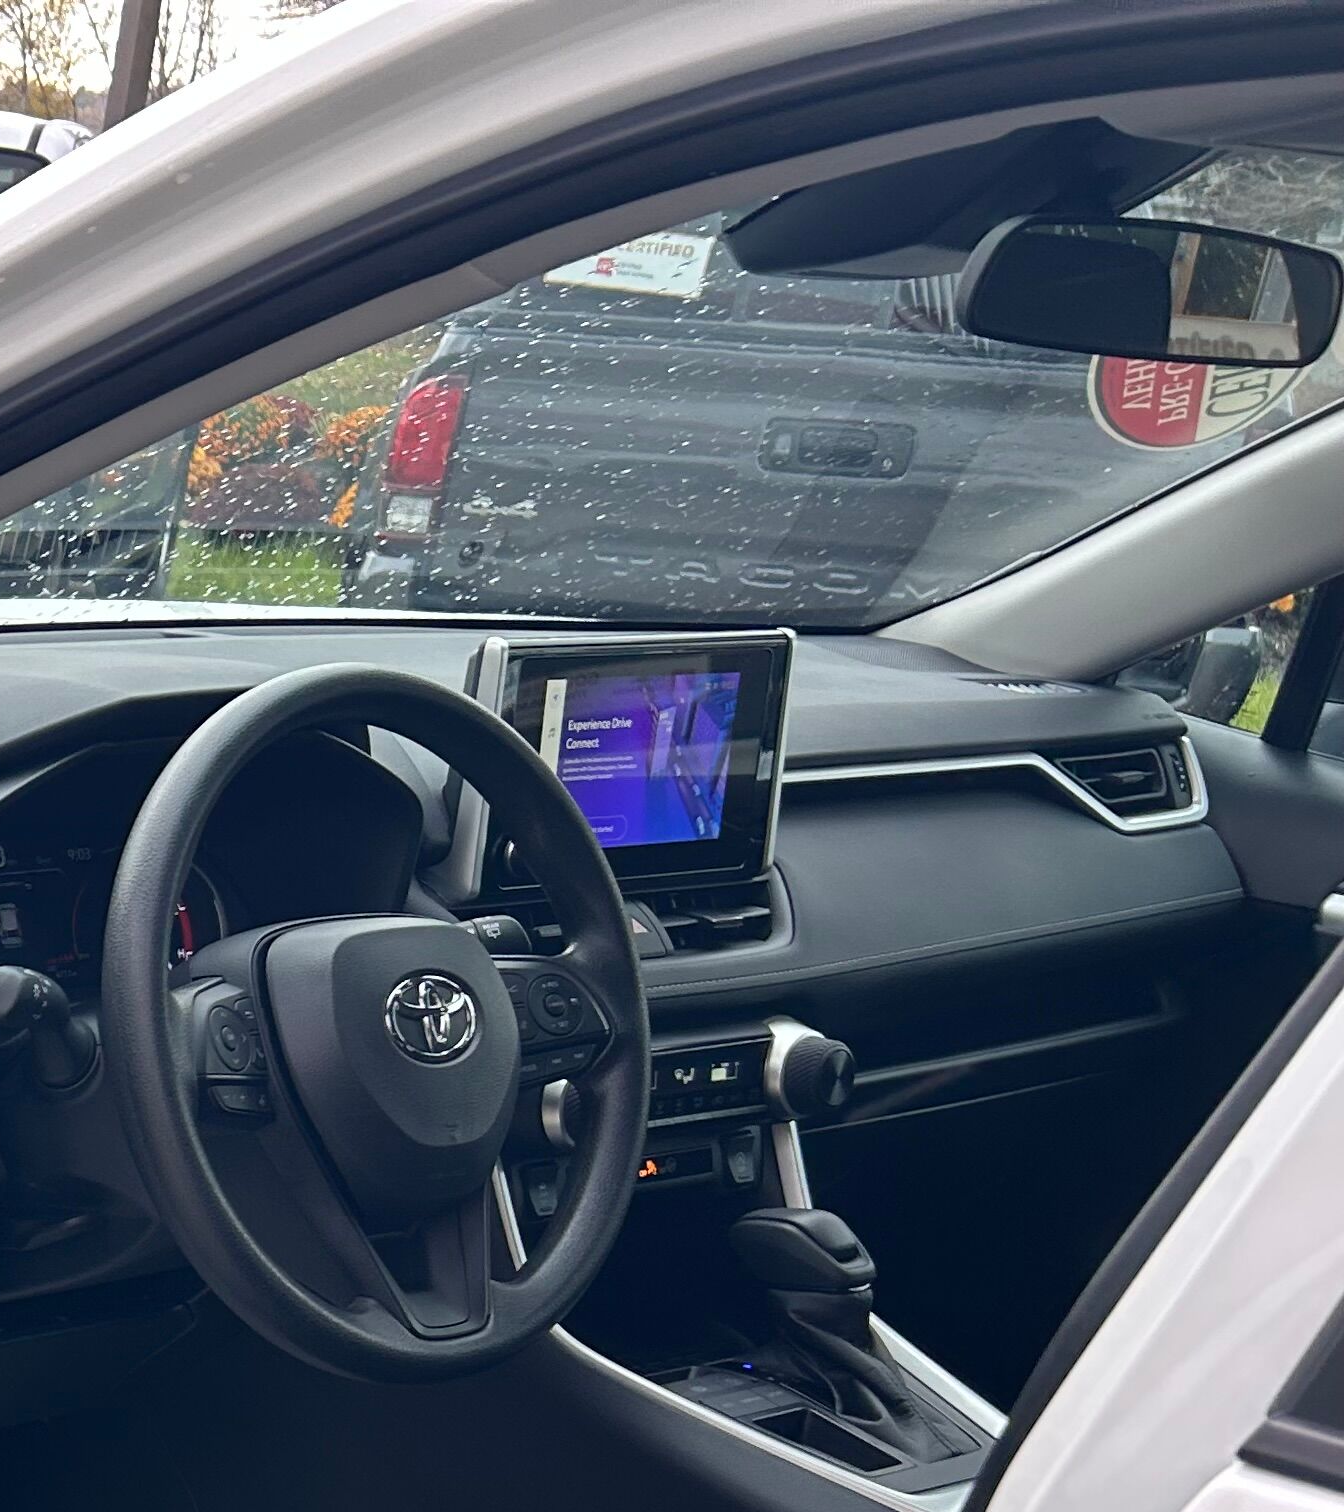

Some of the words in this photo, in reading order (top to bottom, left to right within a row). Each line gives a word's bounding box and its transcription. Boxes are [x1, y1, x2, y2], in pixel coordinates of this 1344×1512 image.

[618, 239, 696, 259] ERTIFIED
[567, 718, 611, 733] Experience
[611, 716, 633, 730] Drive
[565, 737, 600, 750] Connect
